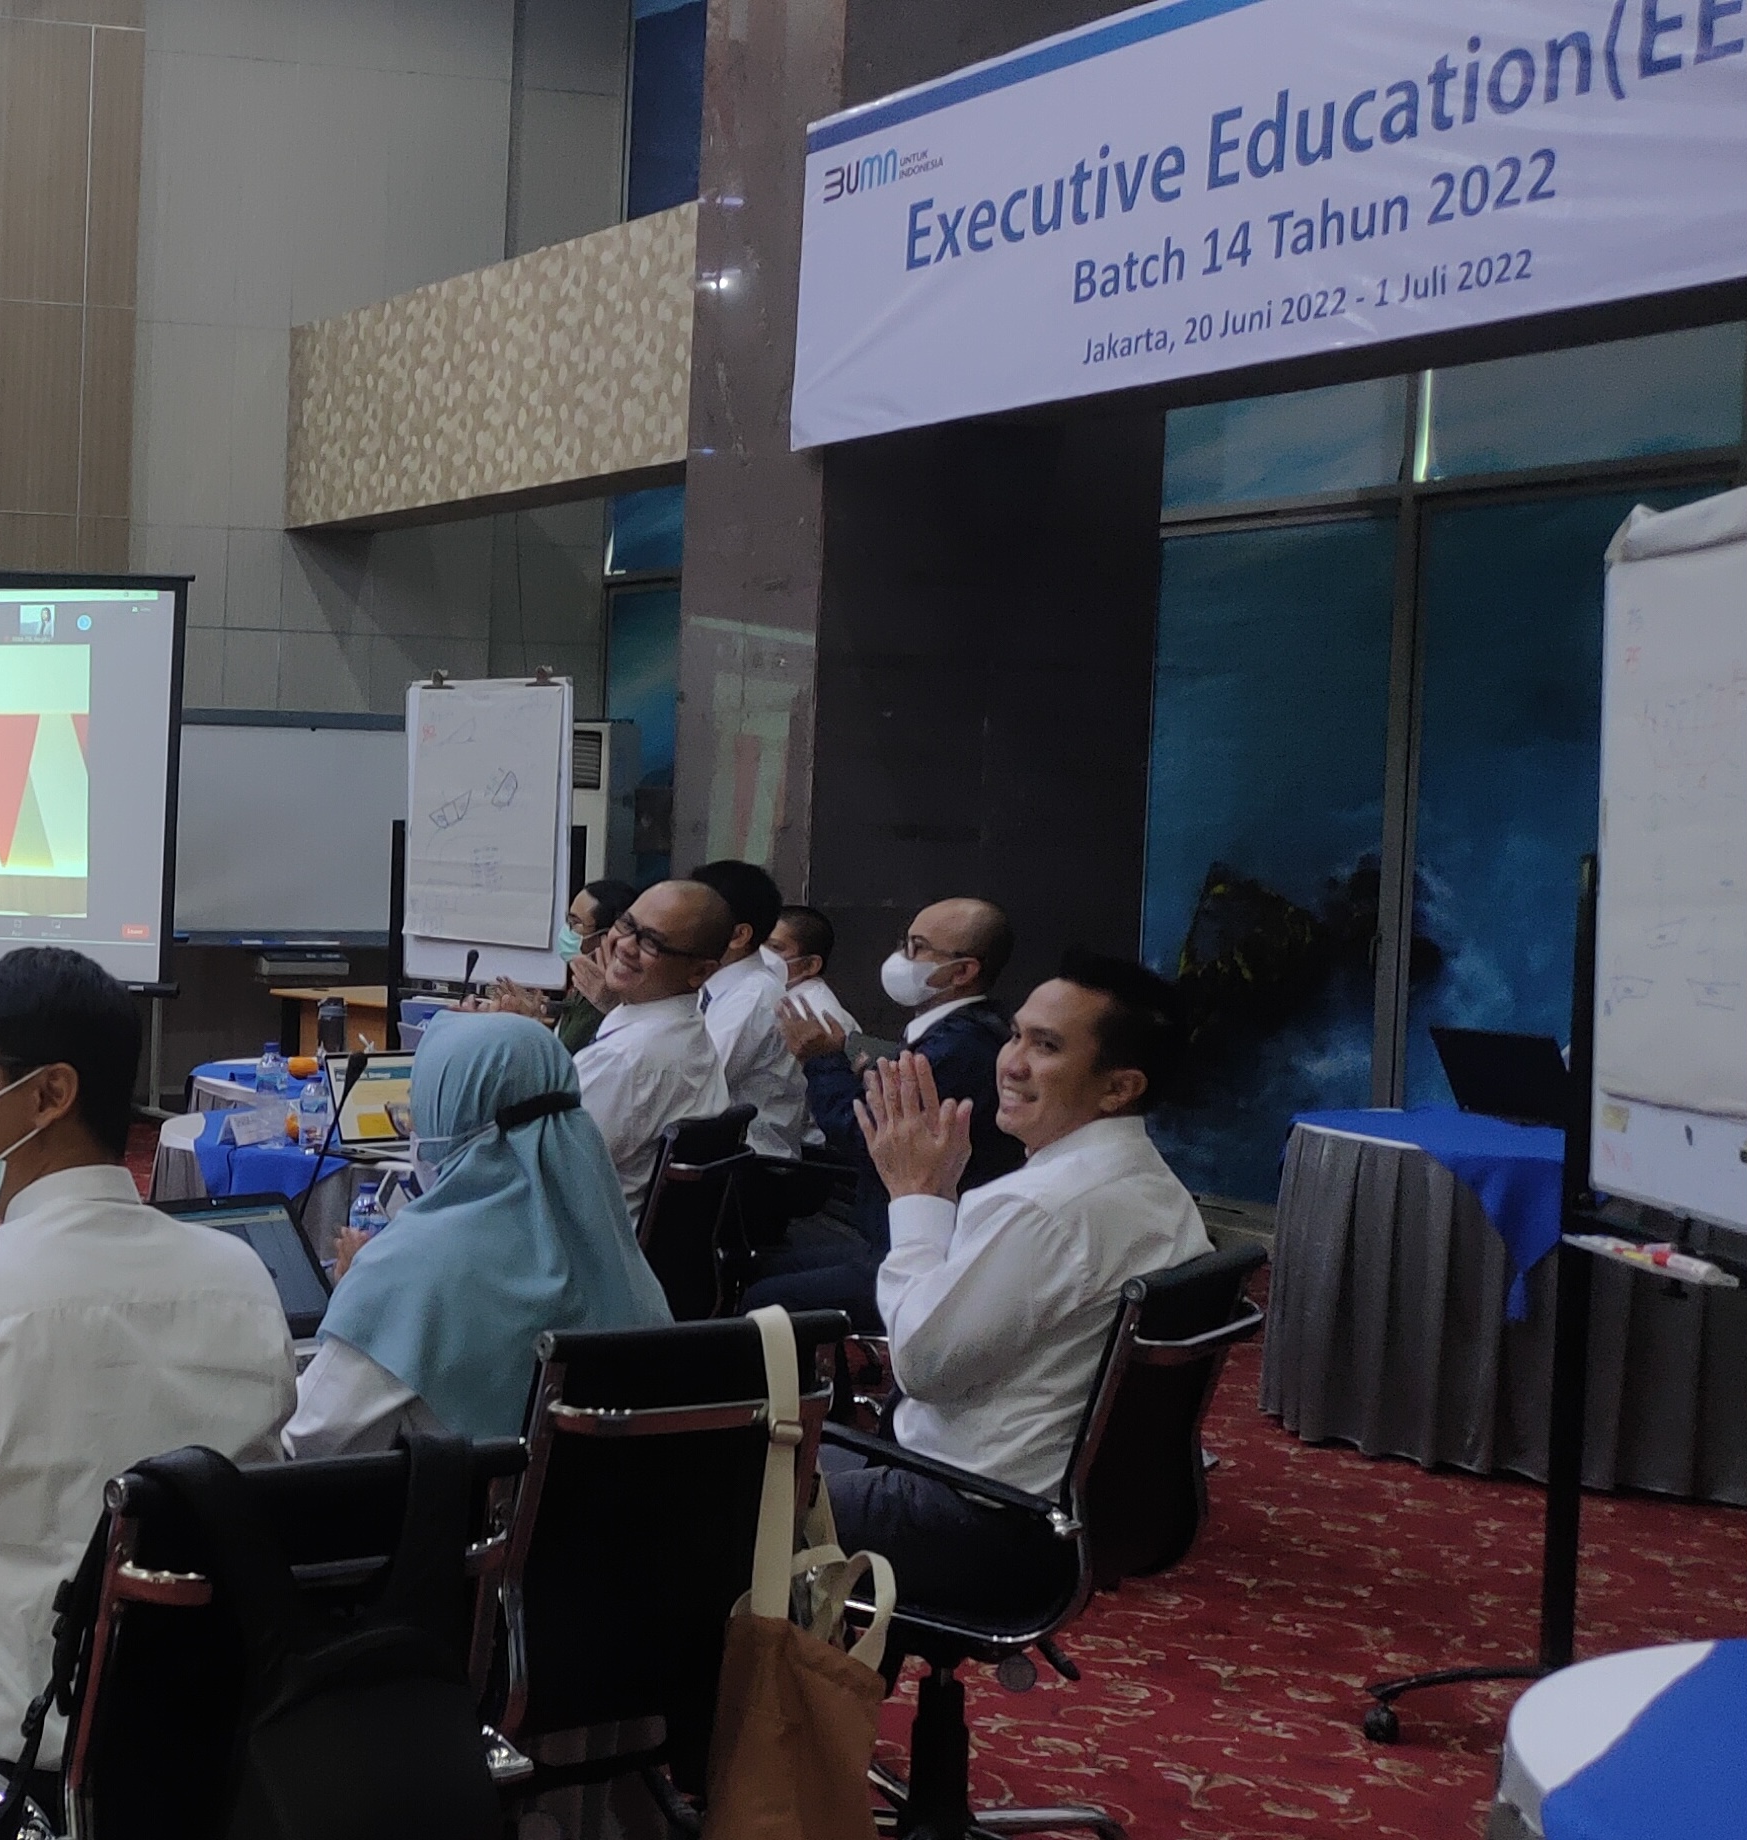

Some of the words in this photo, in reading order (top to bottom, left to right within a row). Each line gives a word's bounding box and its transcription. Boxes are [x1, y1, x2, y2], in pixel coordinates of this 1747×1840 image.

[898, 157, 944, 180] INDONESIA
[899, 149, 929, 167] UNTUK
[906, 144, 1185, 271] Executive
[1074, 236, 1185, 304] Batch
[1202, 220, 1251, 275] 14
[1268, 197, 1408, 259] Tahun
[1427, 149, 1556, 226] 2022
[1082, 328, 1175, 365] Jakarta,
[1184, 313, 1213, 345] 20
[1219, 300, 1272, 338] Juni
[1281, 287, 1346, 325] 2022
[1375, 278, 1388, 307] 1
[1399, 264, 1447, 303] Juli
[1457, 249, 1532, 292] 2022
